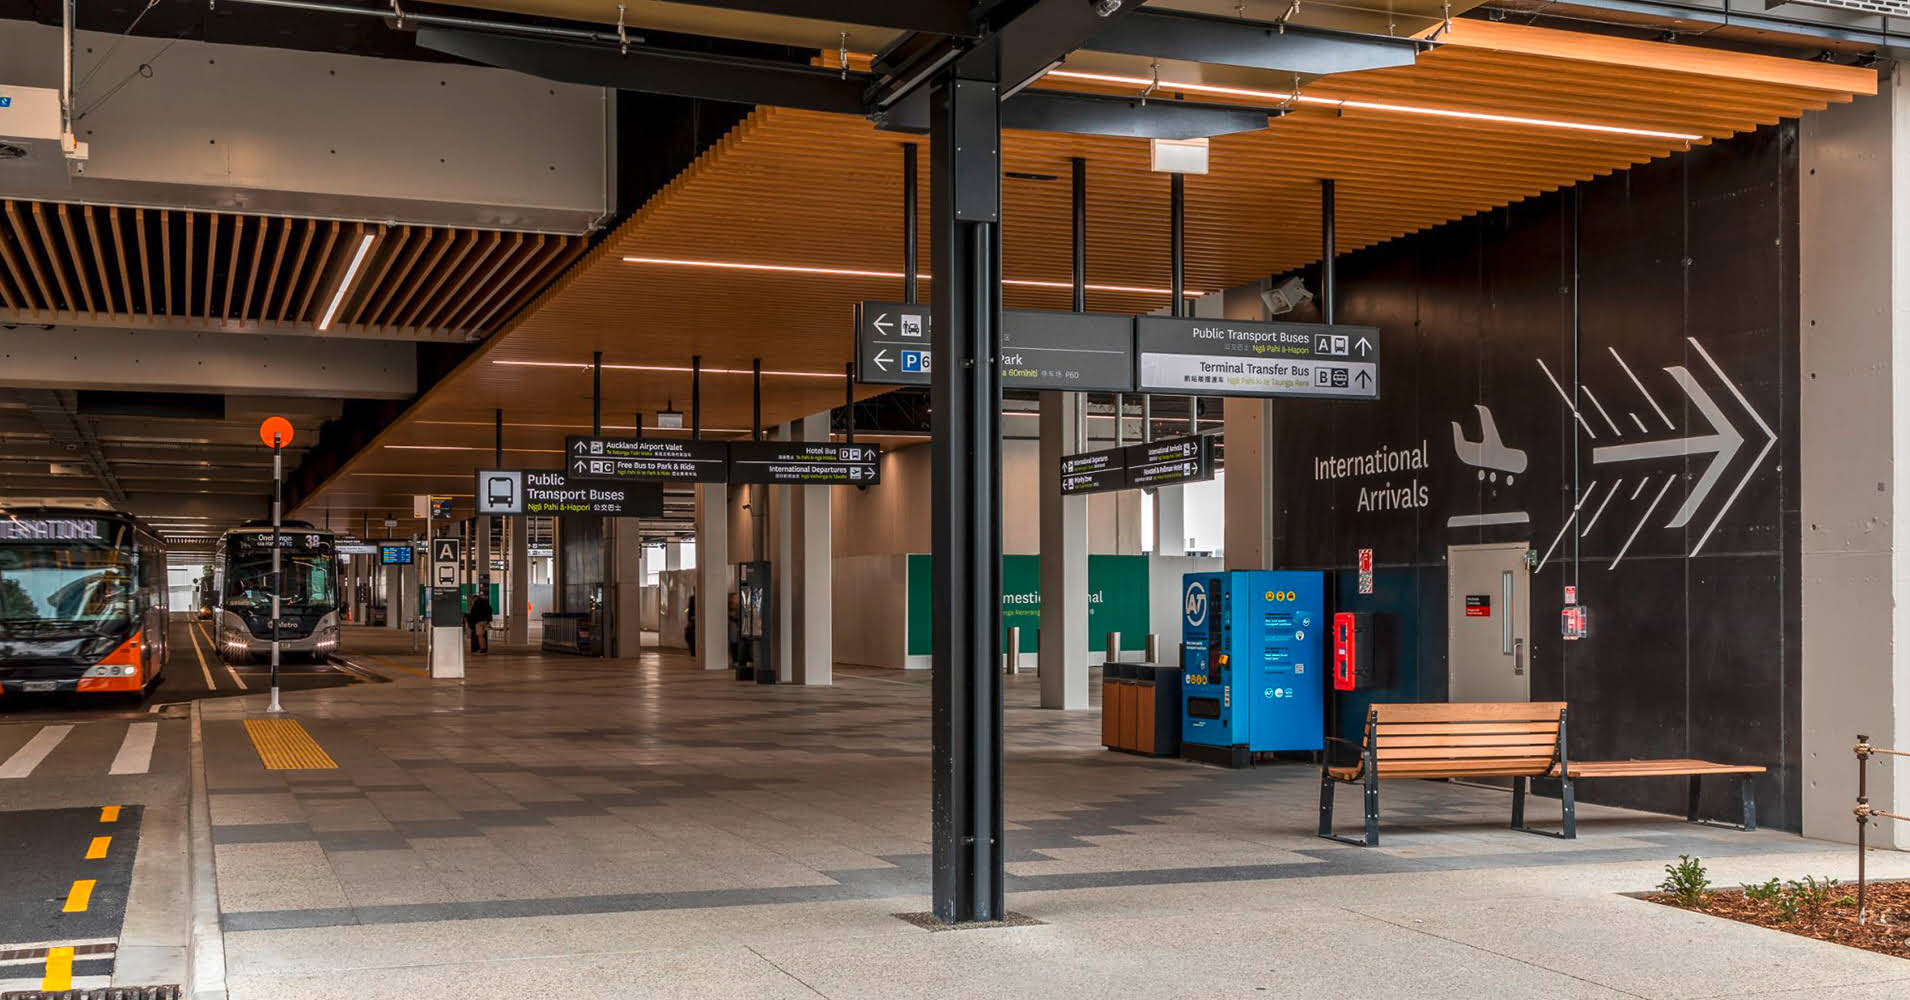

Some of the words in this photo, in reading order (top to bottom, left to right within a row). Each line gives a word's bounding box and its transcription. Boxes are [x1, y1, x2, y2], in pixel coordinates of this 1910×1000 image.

[1192, 328, 1225, 339] Public
[1227, 329, 1277, 342] Transport
[1280, 333, 1310, 344] Buses
[1318, 339, 1329, 351] A
[906, 354, 917, 368] P
[1200, 361, 1244, 374] Terminal
[1246, 363, 1289, 376] Transfer
[1291, 366, 1310, 376] Bus
[1065, 371, 1080, 379] P60
[1319, 371, 1328, 383] B
[605, 441, 639, 451] Auckland
[639, 443, 664, 452] Airport
[665, 443, 683, 452] Valet
[805, 447, 824, 455] Hotel
[842, 450, 849, 459] D
[1315, 440, 1429, 480] International
[604, 463, 612, 472] C
[617, 461, 633, 469] Free
[633, 462, 647, 470] Bus
[647, 462, 656, 470] to
[656, 463, 673, 471] Park
[680, 464, 696, 472] Ride
[769, 465, 811, 473] International
[811, 466, 848, 475] Departures
[527, 473, 565, 486] Public
[527, 488, 587, 502] Transport
[589, 489, 625, 501] Buses
[1357, 479, 1429, 512] Arrivals
[543, 503, 558, 511] Pahi
[593, 503, 622, 512] 公交巴士
[439, 543, 454, 559] A
